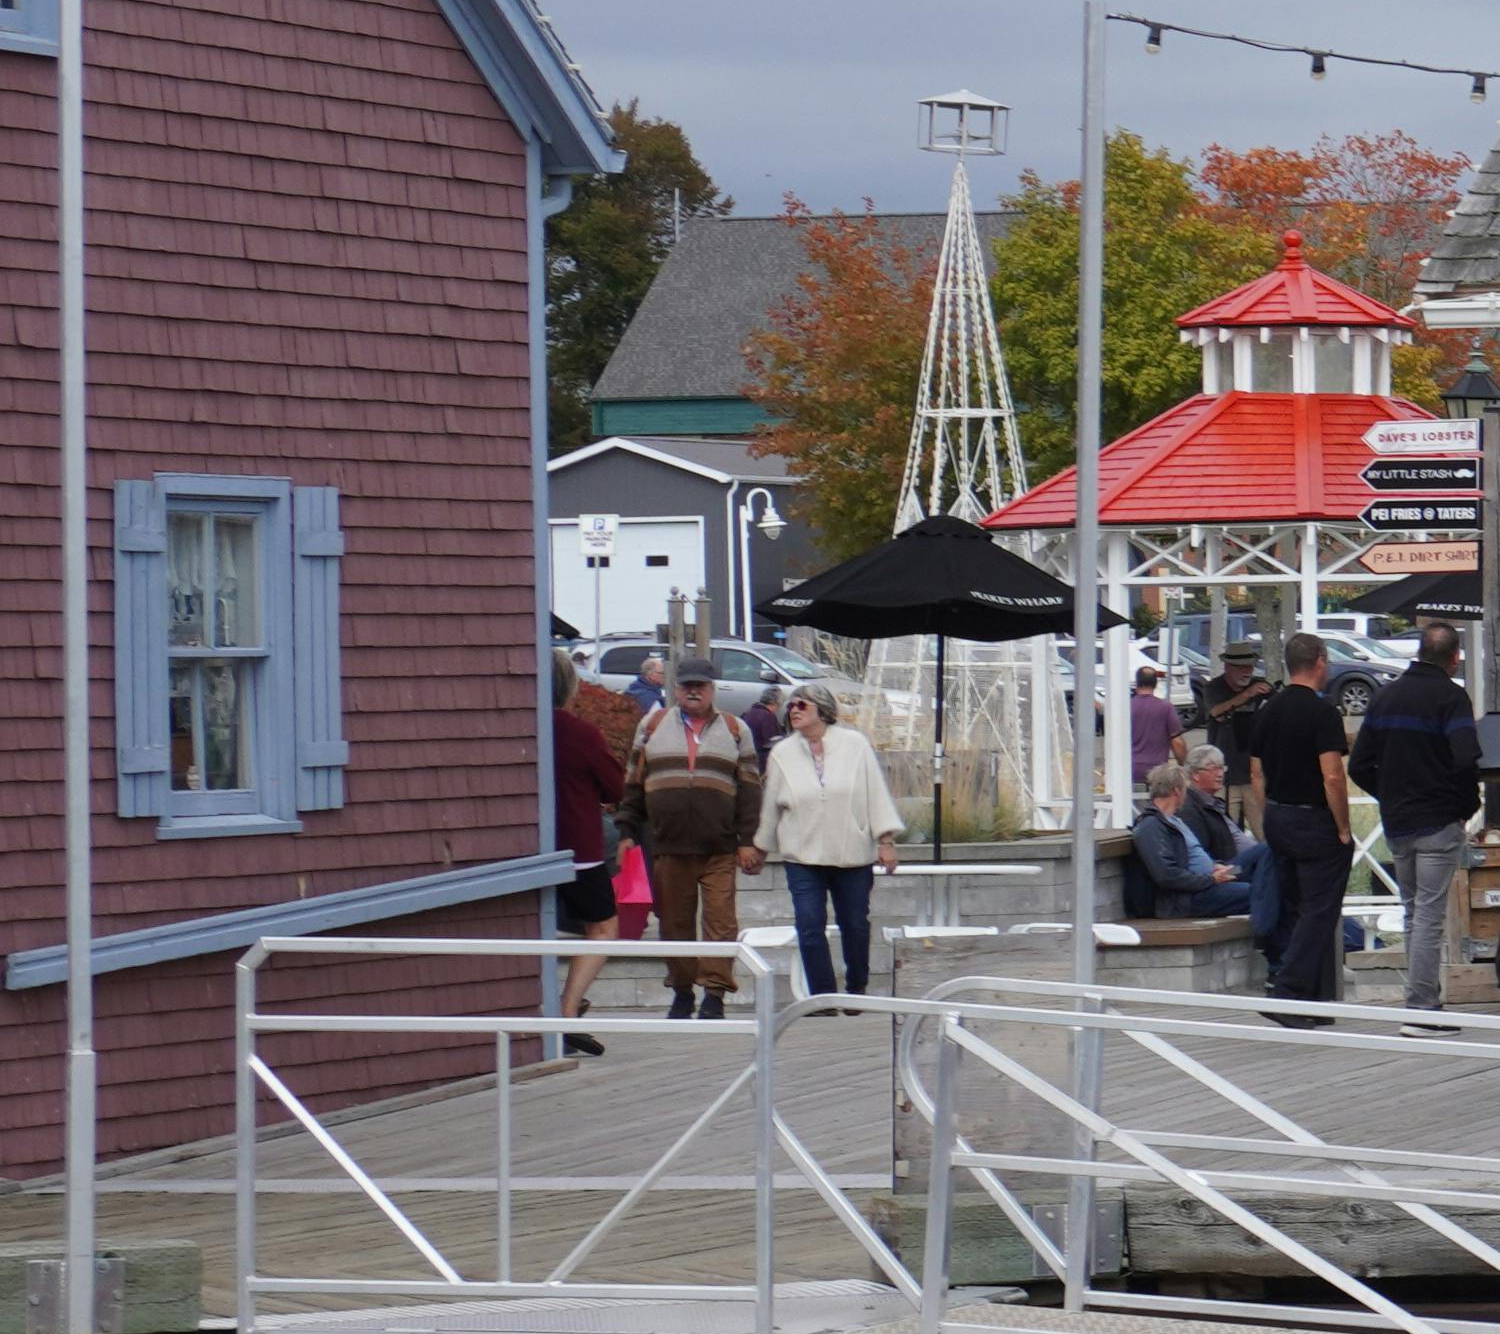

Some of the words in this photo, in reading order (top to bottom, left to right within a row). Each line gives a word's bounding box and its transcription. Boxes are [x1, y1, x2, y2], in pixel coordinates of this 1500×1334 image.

[1377, 433, 1417, 443] DAVE'S
[1422, 430, 1475, 442] LOBSTER
[1366, 470, 1382, 479] MY
[1382, 469, 1418, 479] LITTLE
[1420, 469, 1453, 479] STASH
[1371, 508, 1390, 520] PEI
[1391, 508, 1422, 520] FRIES
[1437, 507, 1476, 520] TATERS
[1410, 551, 1441, 563] DIRT
[1444, 550, 1478, 561] SHIRT
